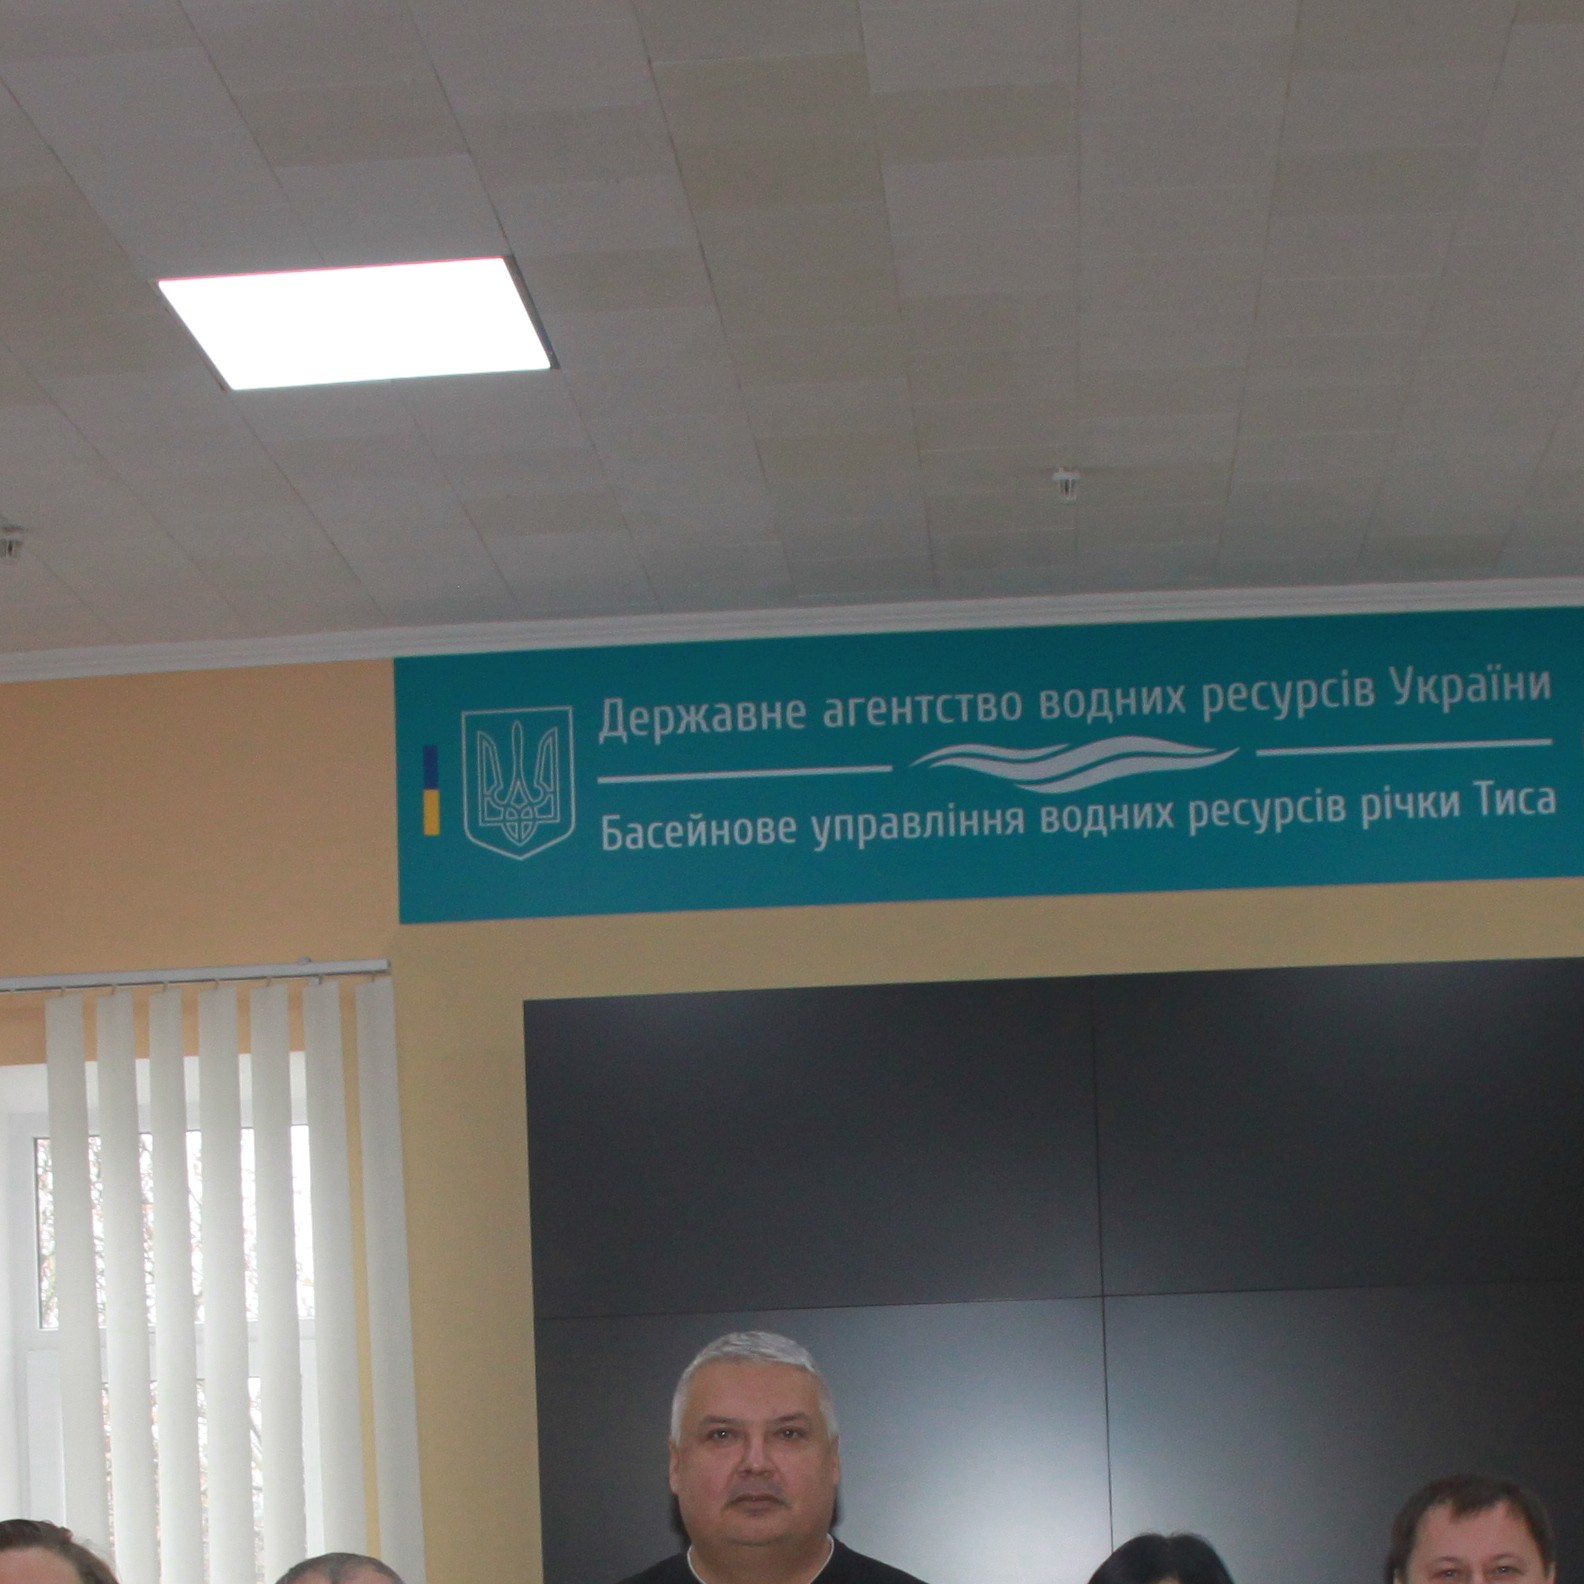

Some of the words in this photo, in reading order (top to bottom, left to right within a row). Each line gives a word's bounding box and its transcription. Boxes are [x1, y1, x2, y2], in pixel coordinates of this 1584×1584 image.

[597, 696, 807, 744] Державне
[822, 692, 1023, 728] агентство
[1039, 684, 1186, 723] водних
[1203, 669, 1375, 721] ресурсів
[1390, 664, 1551, 713] України
[600, 812, 798, 852] Басейнове
[810, 800, 1026, 852] управління
[1040, 801, 1175, 838] водних
[1188, 786, 1348, 836] ресурсів
[1360, 782, 1461, 831] річки
[1472, 780, 1557, 816] Тиса
